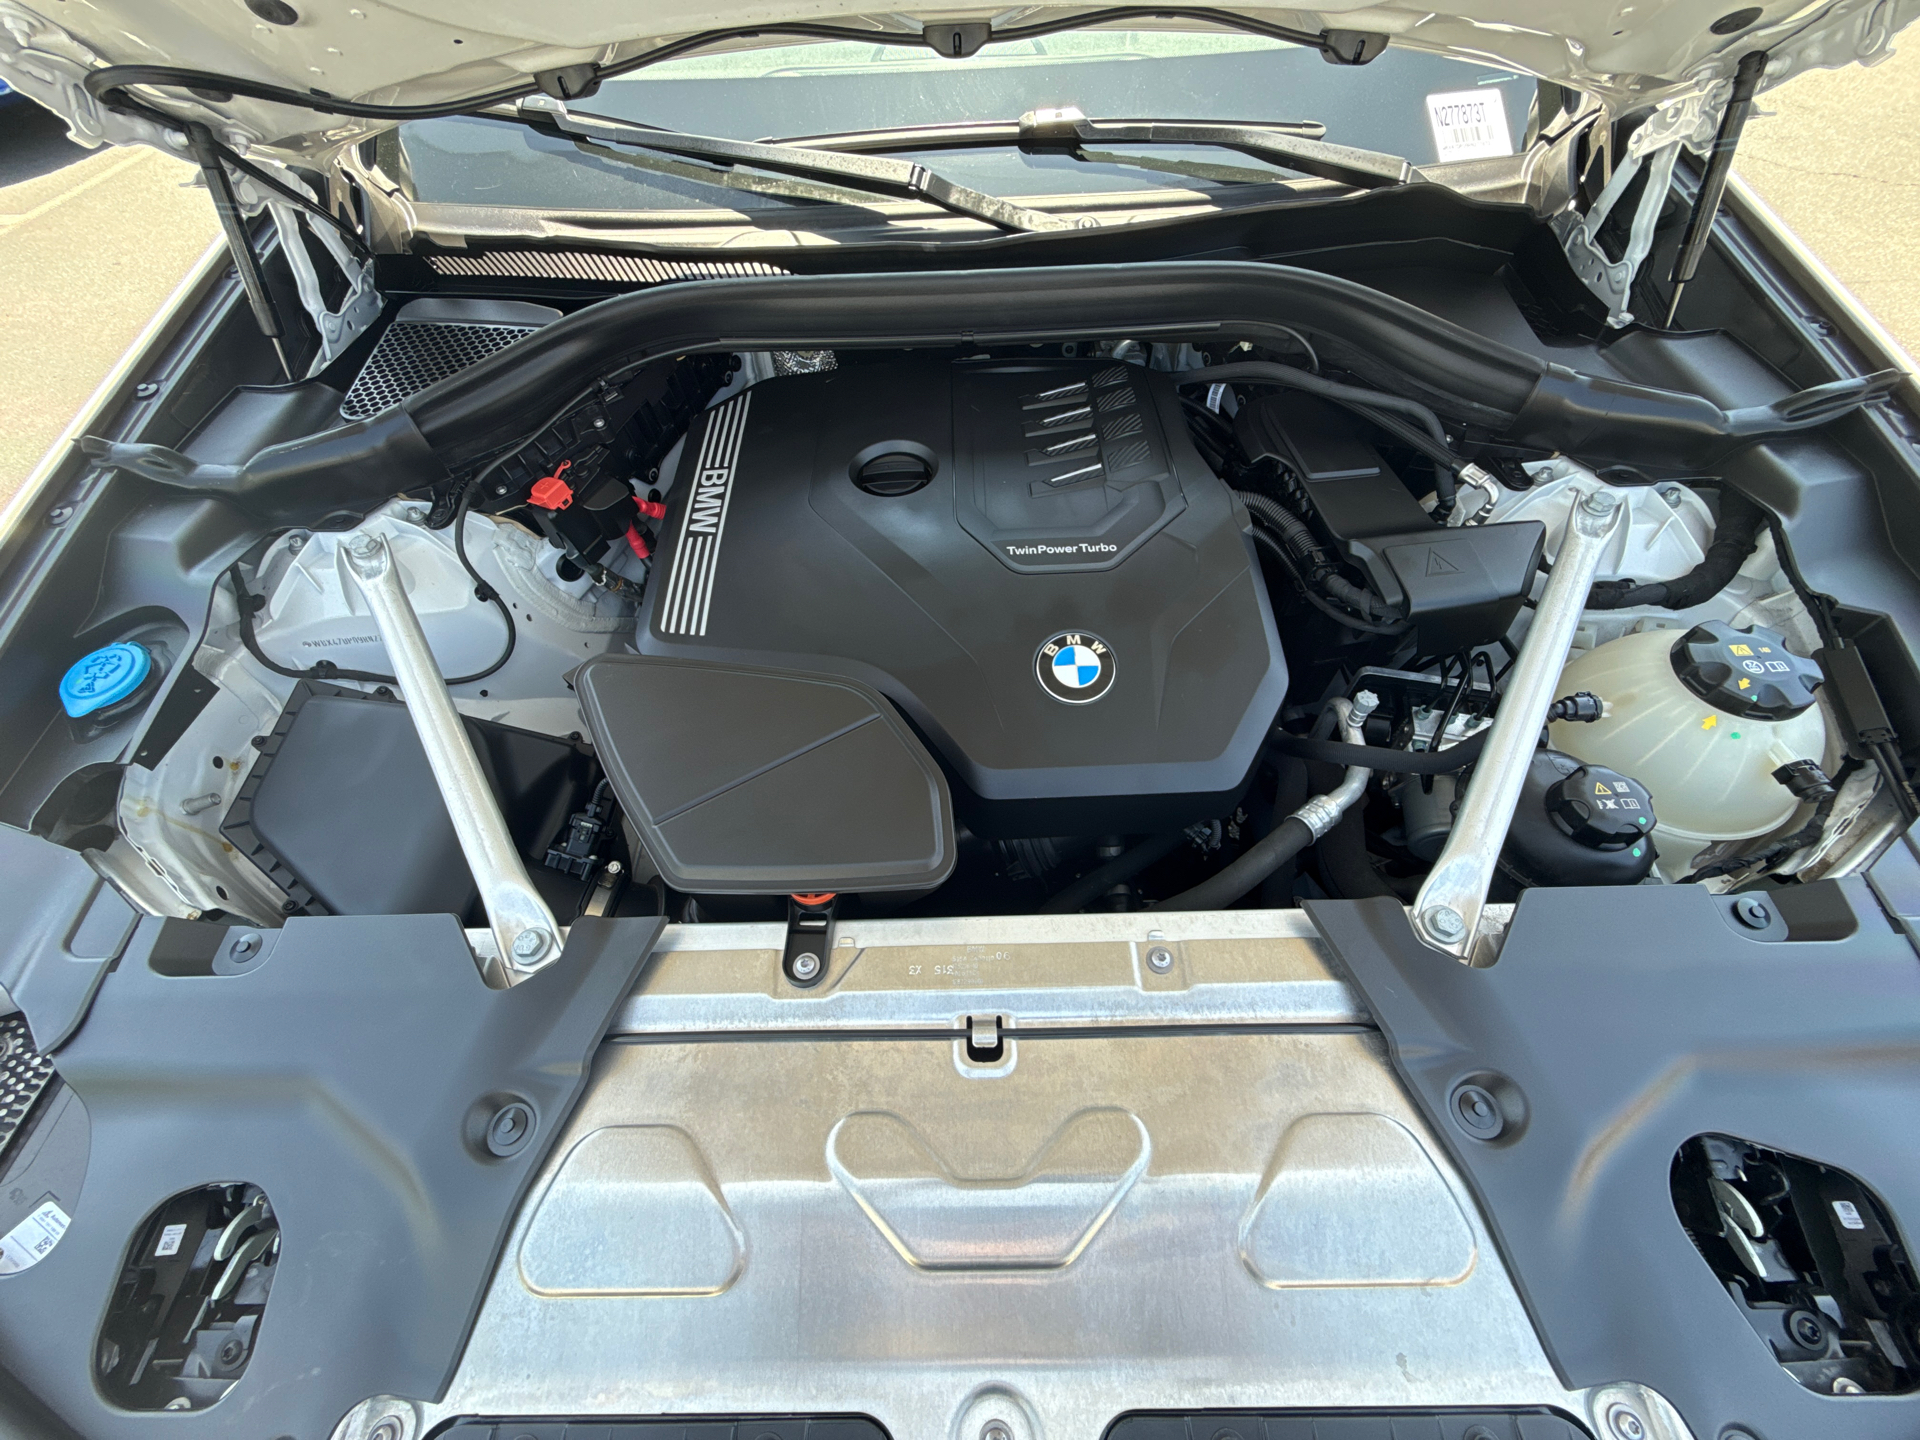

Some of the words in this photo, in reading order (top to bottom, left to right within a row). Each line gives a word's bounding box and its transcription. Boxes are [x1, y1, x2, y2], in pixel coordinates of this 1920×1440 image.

[1434, 102, 1487, 127] N277873T
[688, 468, 729, 533] BMW
[1006, 544, 1078, 556] TwinPower
[1079, 542, 1118, 553] Turbo
[1043, 634, 1107, 657] BMW
